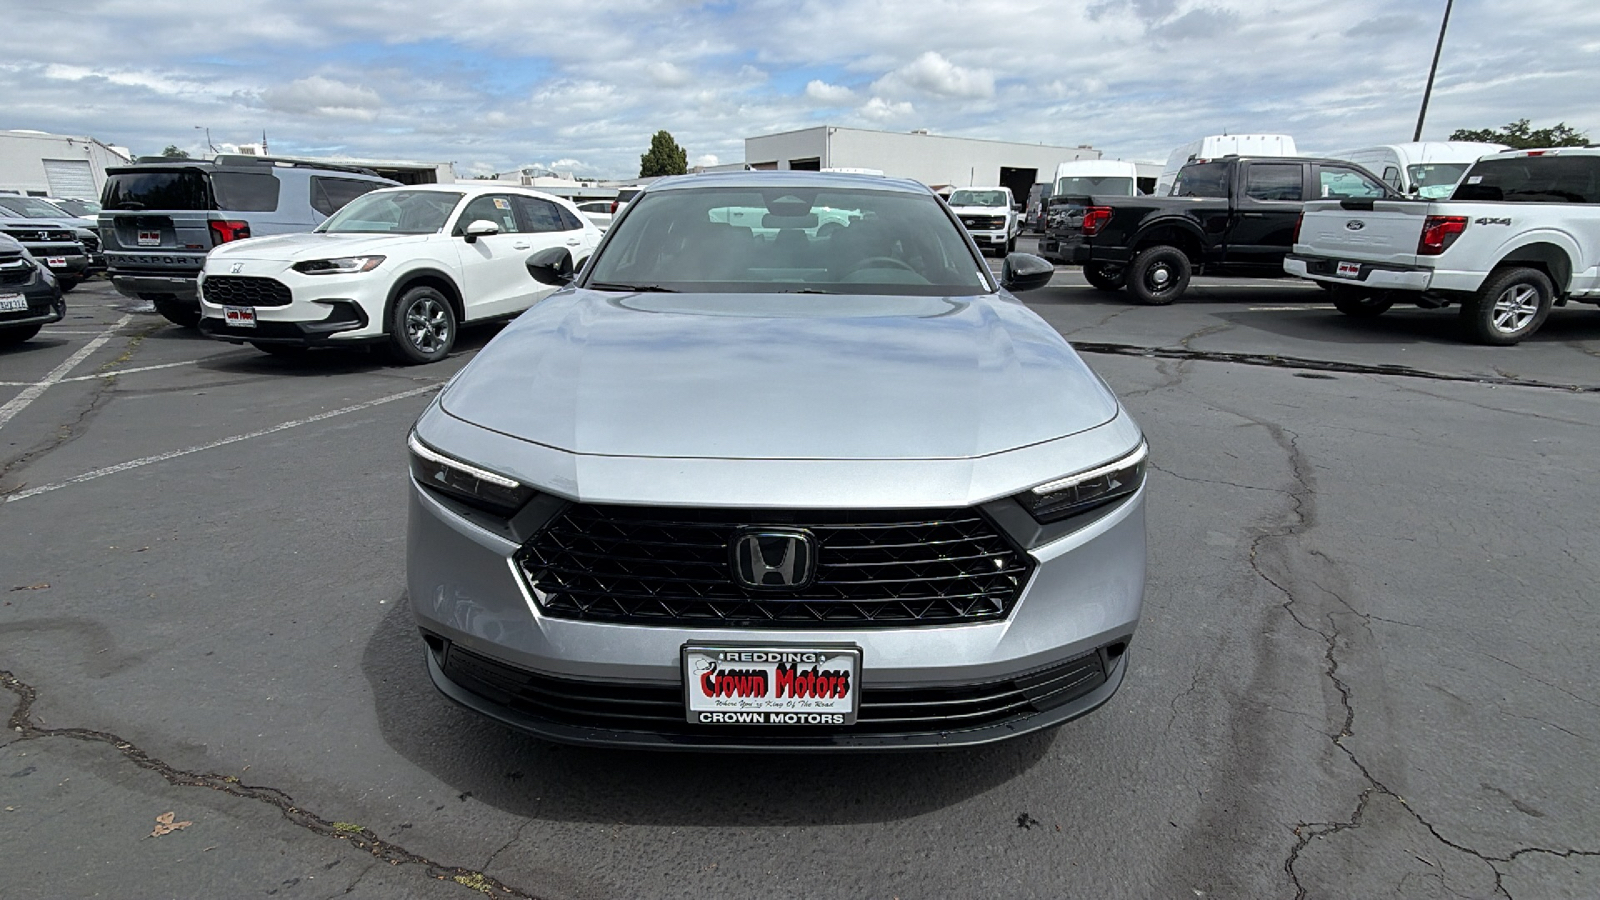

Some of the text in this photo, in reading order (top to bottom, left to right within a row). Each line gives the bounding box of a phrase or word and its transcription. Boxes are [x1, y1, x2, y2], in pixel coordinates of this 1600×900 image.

[108, 255, 202, 265] PASSPORT
[726, 652, 816, 663] REDDING
[700, 663, 851, 699] Crown Motors
[714, 699, 738, 708] Where
[765, 699, 784, 709] King
[786, 700, 796, 709] Of
[797, 700, 812, 708] The
[814, 700, 834, 708] Road
[699, 712, 844, 725] CROWN MOTORS
